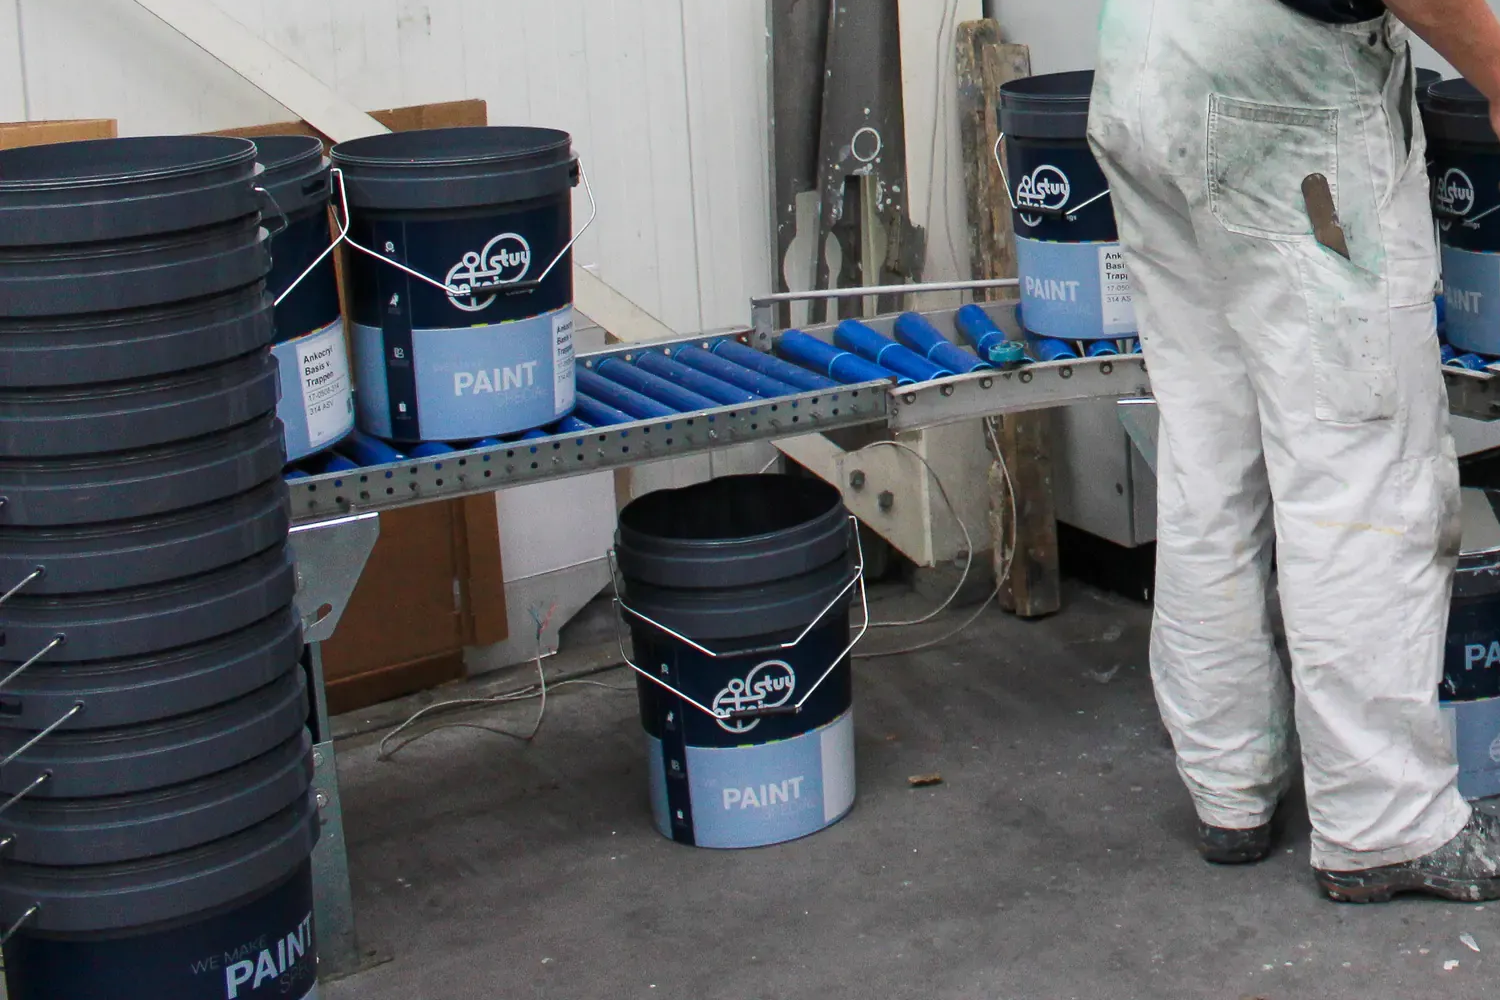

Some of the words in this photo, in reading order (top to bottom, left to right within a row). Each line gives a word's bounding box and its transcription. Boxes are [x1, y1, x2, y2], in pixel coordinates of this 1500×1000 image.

[490, 248, 530, 276] stuy
[1025, 275, 1081, 302] PAINT
[303, 345, 333, 365] Ankocryl
[304, 364, 325, 377] Basis
[306, 371, 334, 388] Trappen
[454, 360, 537, 396] PAINT
[722, 775, 804, 810] PAINT
[190, 956, 221, 975] WE
[223, 934, 268, 964] MAKE
[226, 910, 312, 1000] PAINT
